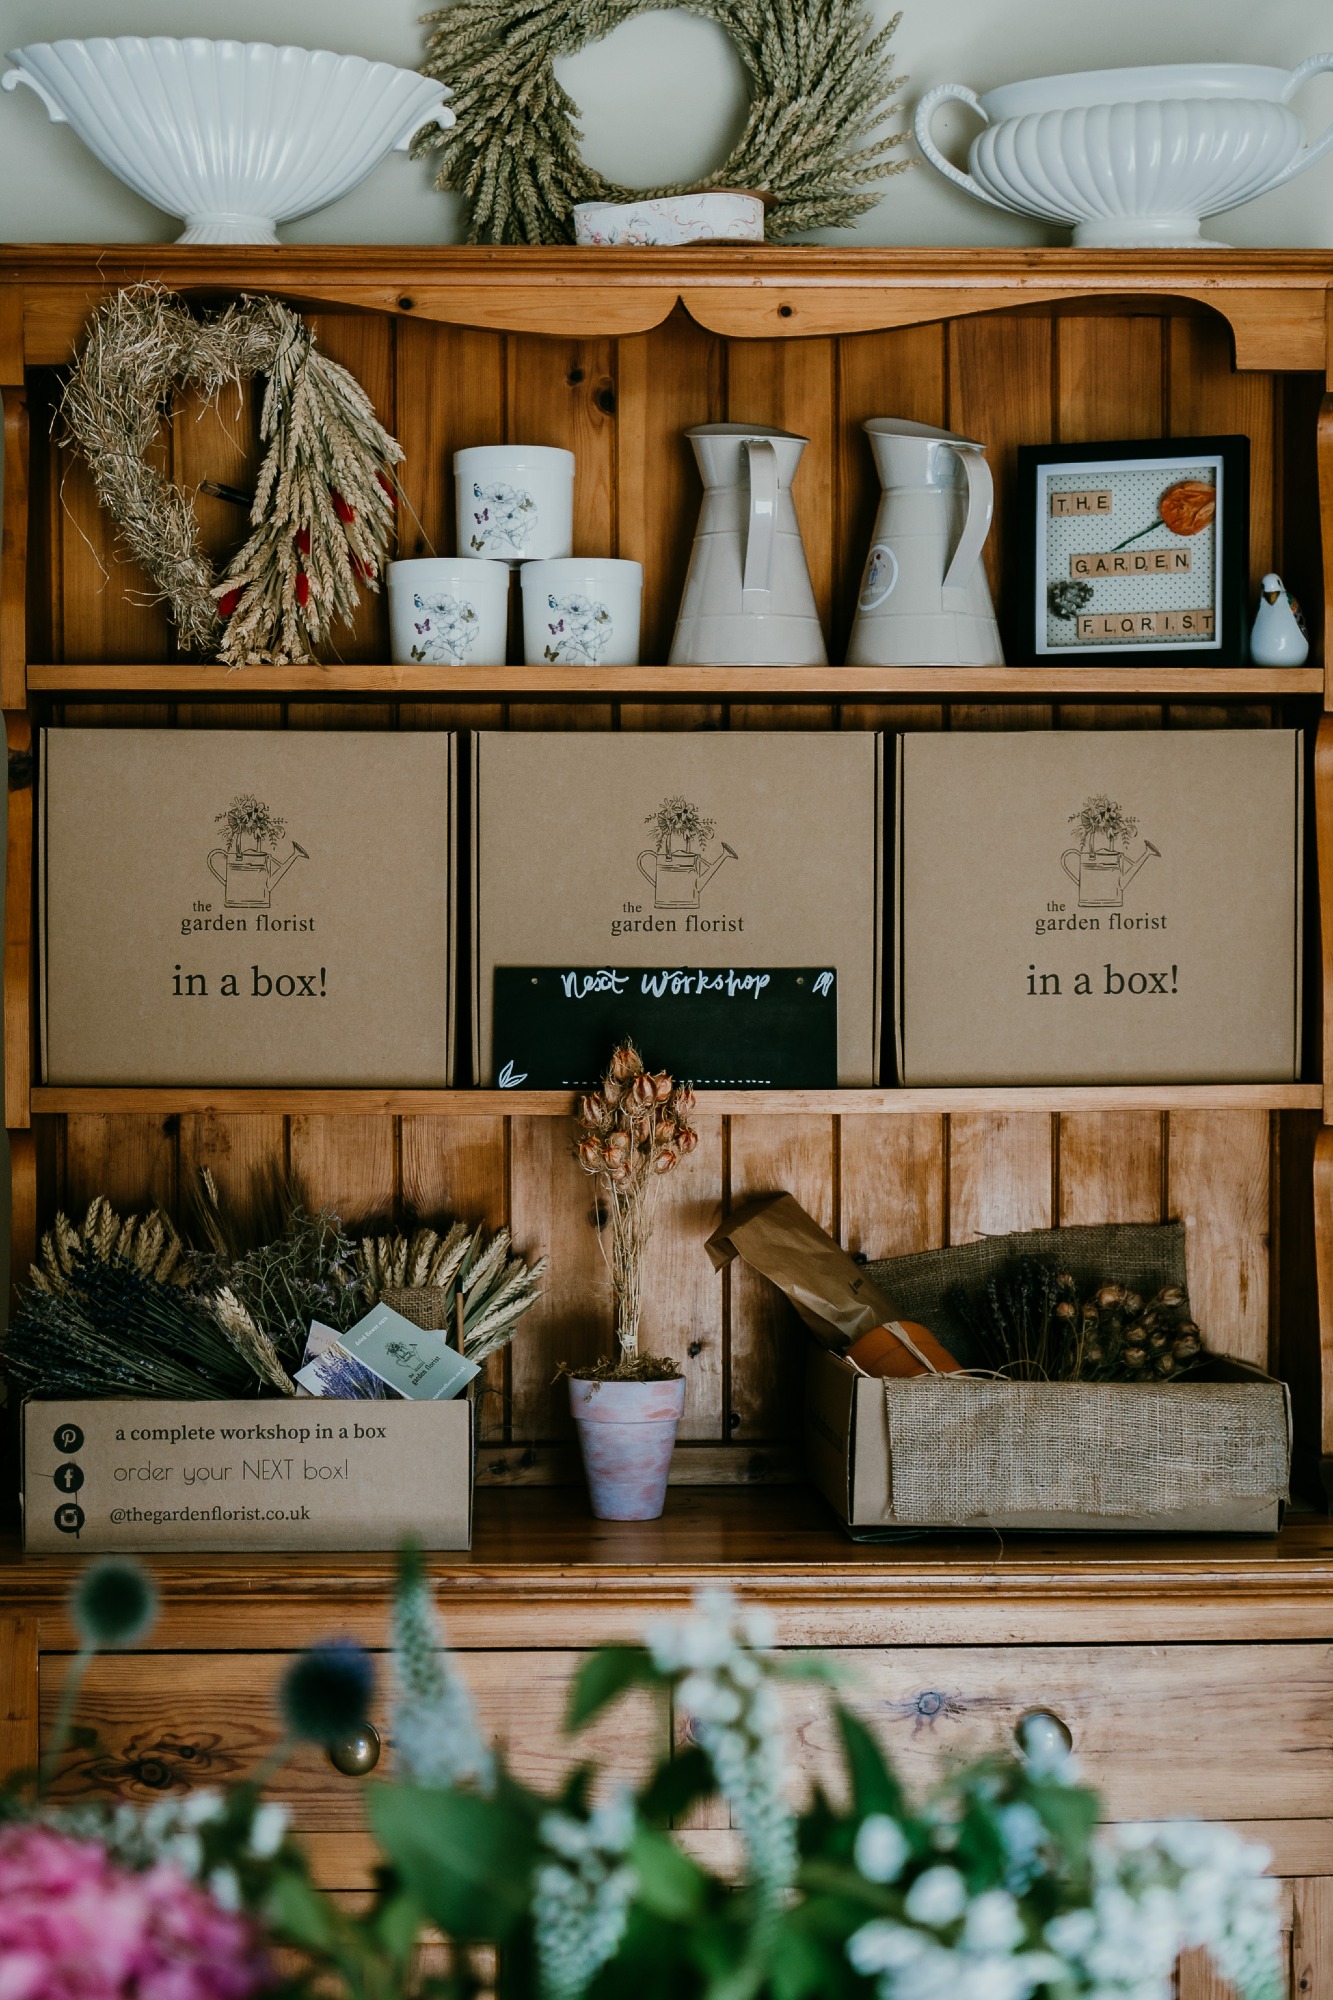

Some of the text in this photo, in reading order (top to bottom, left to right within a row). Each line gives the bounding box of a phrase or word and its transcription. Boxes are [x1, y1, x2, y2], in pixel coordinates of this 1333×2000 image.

[1057, 495, 1109, 513] THE
[1075, 554, 1188, 574] GARDEN
[1083, 615, 1213, 634] FLORIST
[192, 900, 212, 912] the
[622, 901, 642, 913] the
[1046, 900, 1066, 912] the
[180, 914, 316, 935] garden florist
[611, 915, 744, 936] garden florist
[1035, 913, 1167, 935] garden florist
[172, 964, 327, 997] in a box!
[641, 969, 771, 999] Workshop
[1026, 964, 1178, 996] in a box!
[411, 1356, 441, 1386] garden florist
[115, 1424, 386, 1444] a complete workshop in a box
[113, 1459, 349, 1485] order your NEXT box!
[110, 1506, 311, 1524] @thegardenflorist.co.uk
